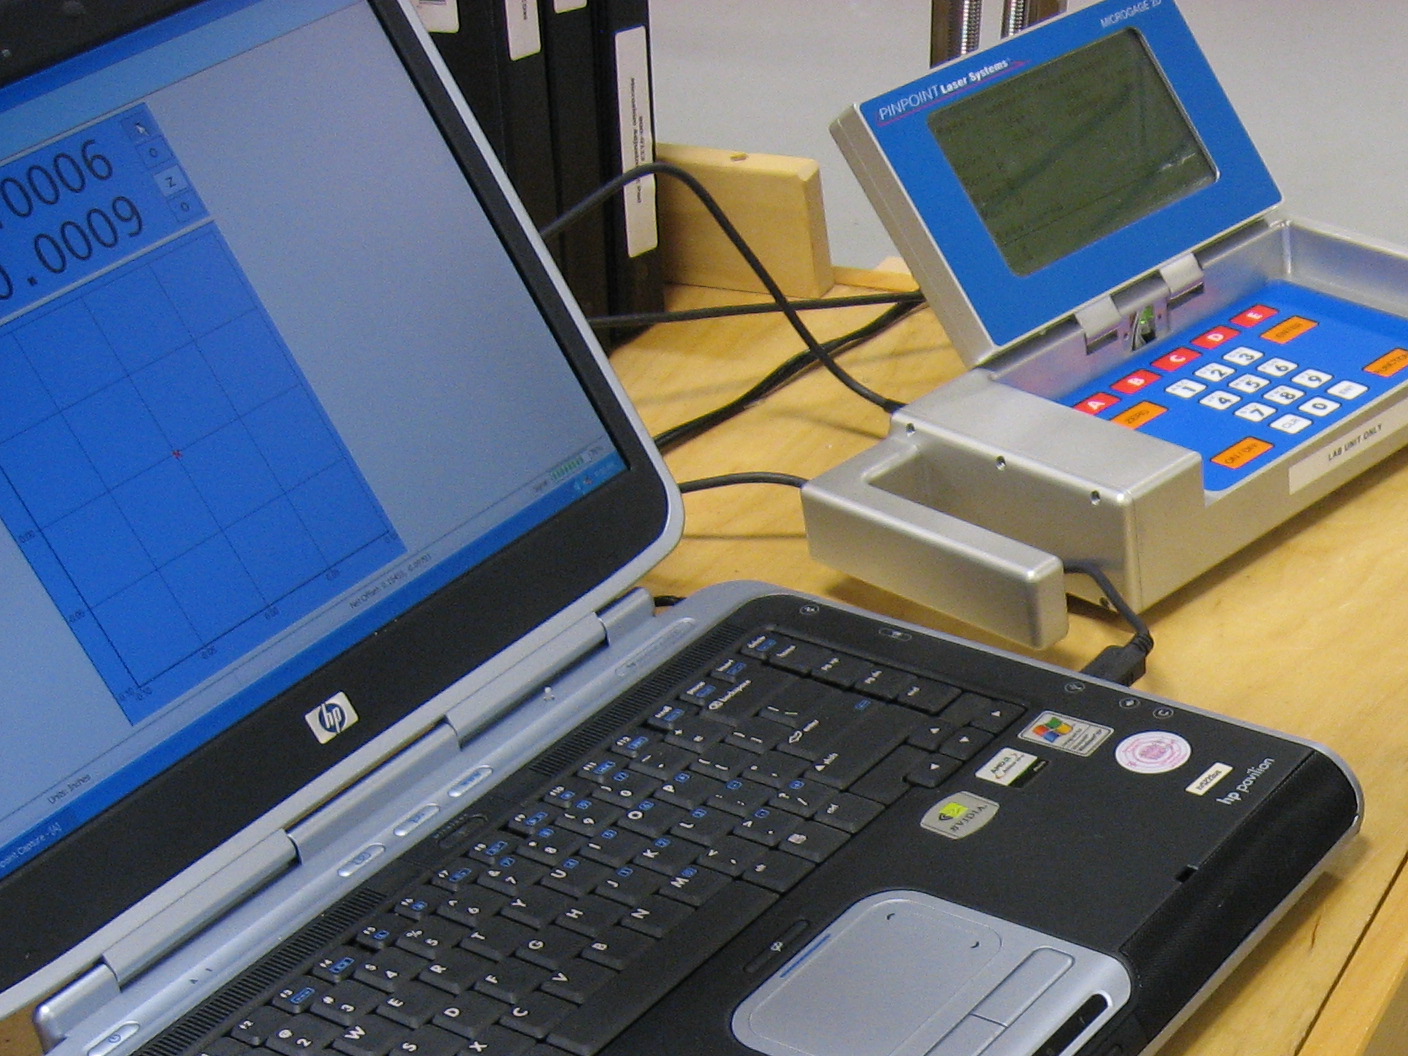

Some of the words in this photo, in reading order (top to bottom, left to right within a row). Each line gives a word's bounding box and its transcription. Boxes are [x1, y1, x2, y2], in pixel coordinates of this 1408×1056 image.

[1100, 0, 1149, 28] MICROGAGE
[878, 85, 939, 120] PINPOINT
[939, 77, 968, 94] Laser
[968, 59, 1009, 82] Systems
[0, 139, 113, 228] 0006
[1247, 311, 1263, 320] E
[1207, 333, 1224, 342] D
[1170, 354, 1186, 362] C
[1238, 352, 1255, 361] 3
[1210, 368, 1227, 378] 2
[1275, 364, 1289, 372] 6
[1127, 377, 1145, 387] B
[1245, 379, 1260, 389] 5
[1308, 375, 1322, 383] 9
[1218, 396, 1232, 405] 4
[1280, 391, 1296, 400] 8
[1088, 400, 1105, 411] A
[1311, 402, 1327, 410] 0
[1250, 407, 1264, 417] 7
[1327, 447, 1342, 461] LAB
[1344, 435, 1361, 451] UNIT
[1363, 423, 1382, 440] ONLY
[320, 703, 342, 734] hp
[1216, 791, 1242, 806] hp
[1236, 757, 1276, 793] pavilion
[627, 810, 643, 820] O
[643, 849, 660, 859] K
[550, 869, 567, 878] U
[670, 876, 689, 888] M
[511, 898, 526, 908] Y
[565, 908, 584, 919] H
[631, 908, 650, 919] N
[471, 932, 485, 941] T
[528, 939, 544, 950] G
[591, 942, 608, 951] B
[430, 964, 447, 974] R
[485, 974, 498, 984] F
[552, 972, 569, 982] V
[341, 1004, 355, 1012] 3
[387, 998, 404, 1008] E
[443, 1007, 460, 1018] D
[512, 1007, 529, 1017] C
[344, 1025, 366, 1040] W
[296, 1037, 312, 1047] 2
[402, 1042, 418, 1052] S
[469, 1040, 488, 1053] X
